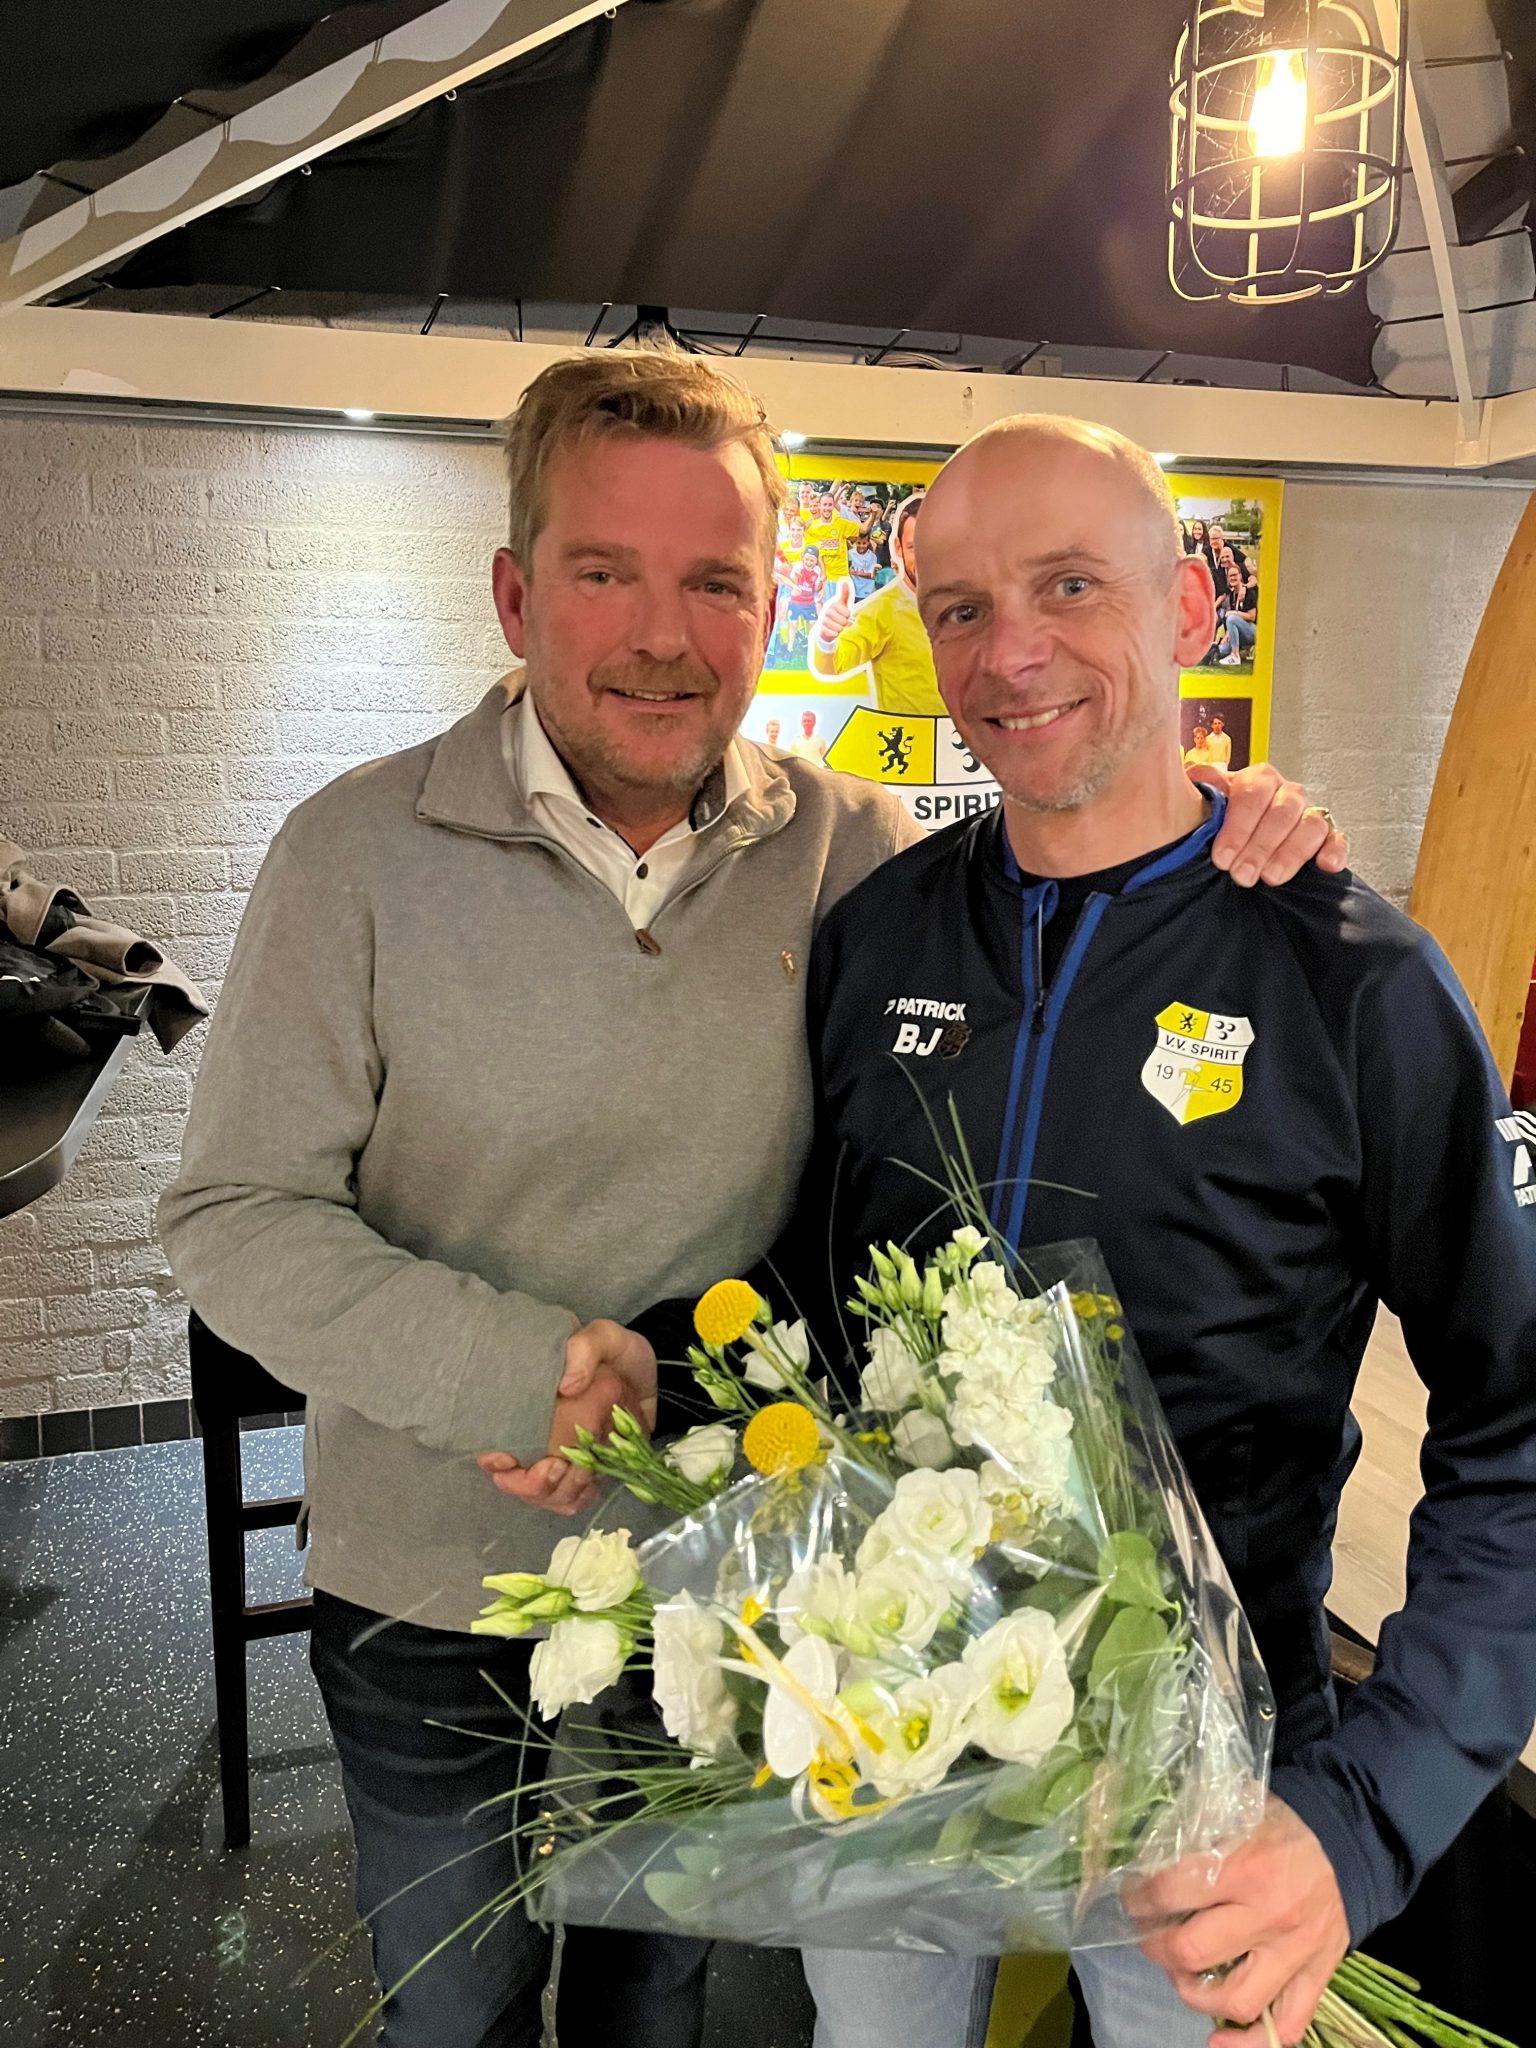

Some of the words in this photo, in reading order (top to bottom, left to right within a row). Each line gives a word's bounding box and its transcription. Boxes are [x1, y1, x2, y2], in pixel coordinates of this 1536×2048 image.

[896, 997, 967, 1022] PATRICK
[892, 1022, 944, 1057] BJ
[1165, 1034, 1187, 1051] V.V.
[1190, 1043, 1239, 1061] SPIRIT
[1155, 1063, 1174, 1080] 19
[1210, 1078, 1233, 1094] 45
